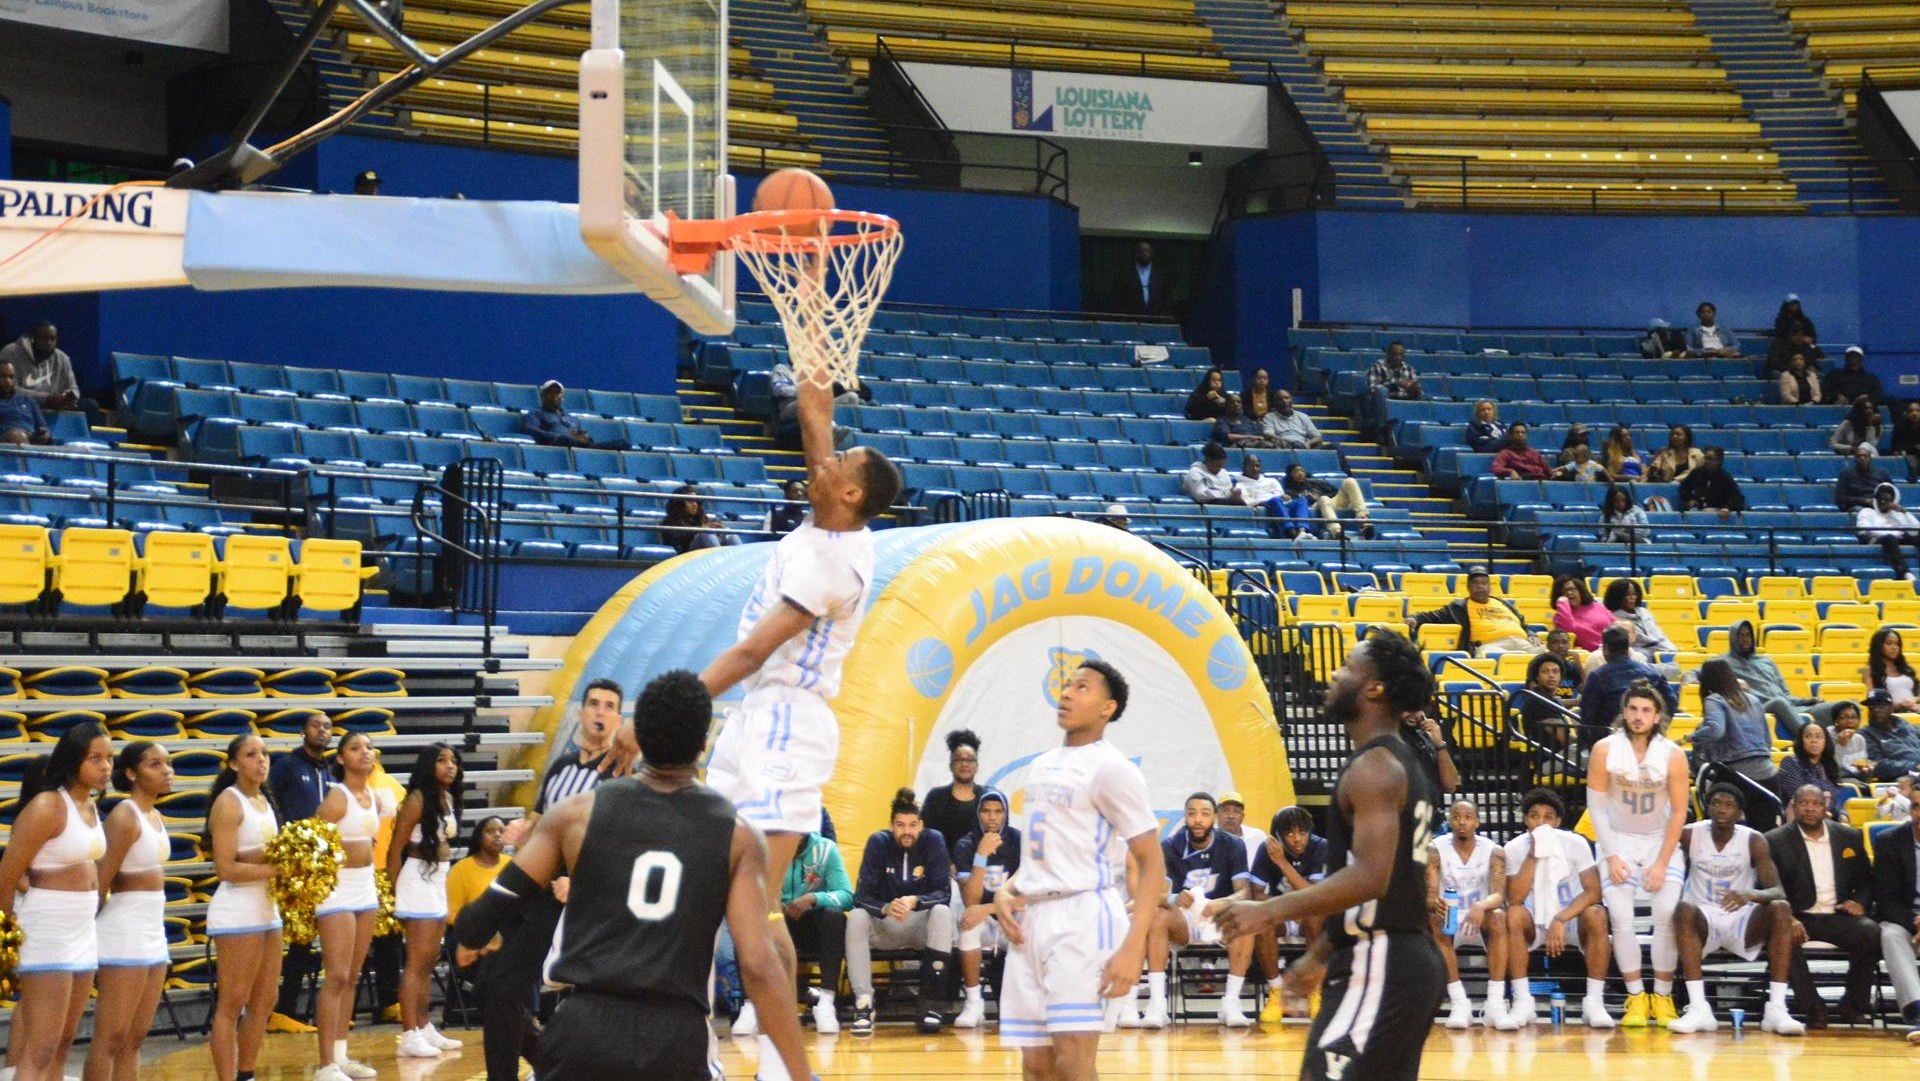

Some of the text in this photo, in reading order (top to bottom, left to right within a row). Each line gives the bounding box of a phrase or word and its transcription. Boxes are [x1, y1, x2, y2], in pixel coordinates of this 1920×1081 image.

[87, 2, 149, 20] Bookstore
[1055, 85, 1153, 112] LOUISIANA
[1063, 106, 1146, 130] LOTTERY
[1063, 127, 1144, 139] CORPORATION
[966, 555, 1213, 647] JAG DOME
[1622, 790, 1656, 814] 40
[1028, 810, 1047, 861] 5
[626, 849, 684, 920] 0
